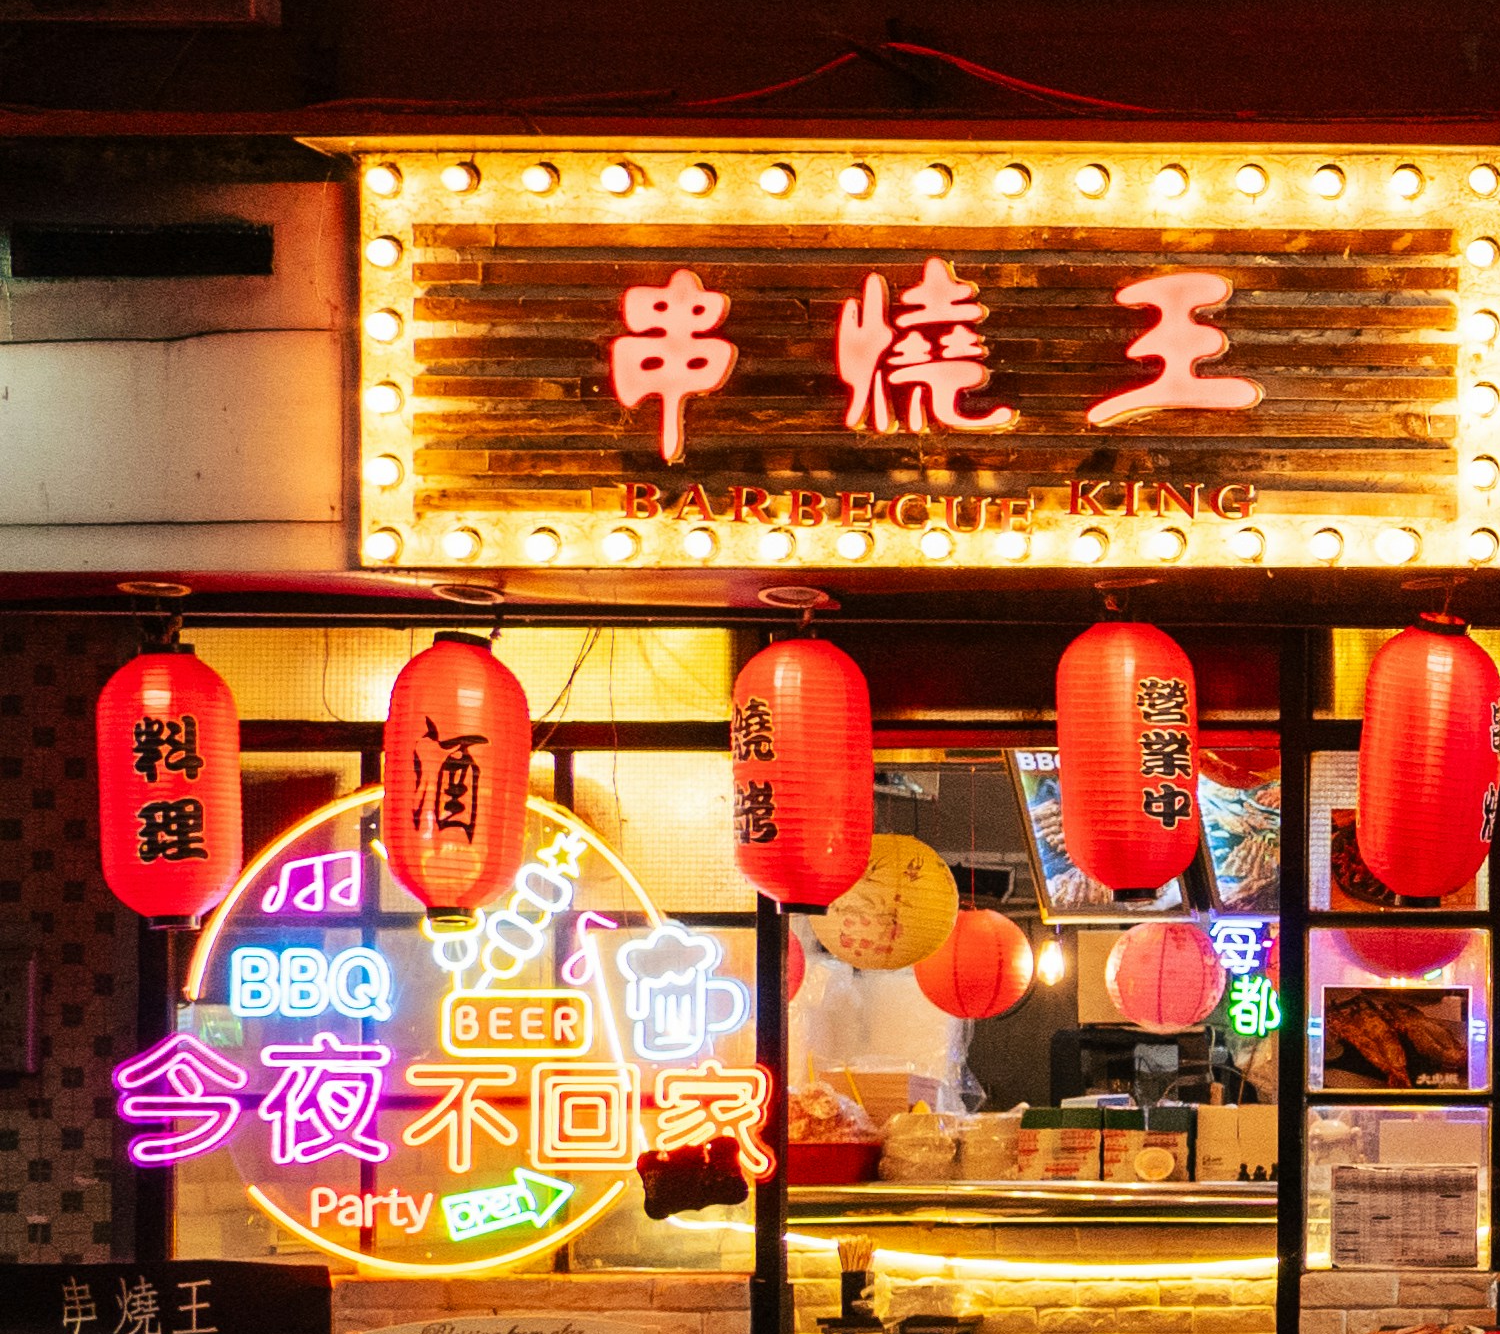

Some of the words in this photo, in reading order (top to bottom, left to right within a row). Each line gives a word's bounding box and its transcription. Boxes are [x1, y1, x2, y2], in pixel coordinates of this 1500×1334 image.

[609, 256, 1266, 463] 串燒王
[622, 481, 1036, 535] BARBECUE
[1067, 479, 1258, 521] KING
[131, 715, 207, 864] 料理
[413, 717, 491, 845] 酒
[1138, 677, 1194, 830] 營業中
[229, 946, 393, 1023] BBQ
[454, 1006, 579, 1044] BEER
[114, 1031, 776, 1182] 今夜不回家
[310, 1188, 434, 1231] Party
